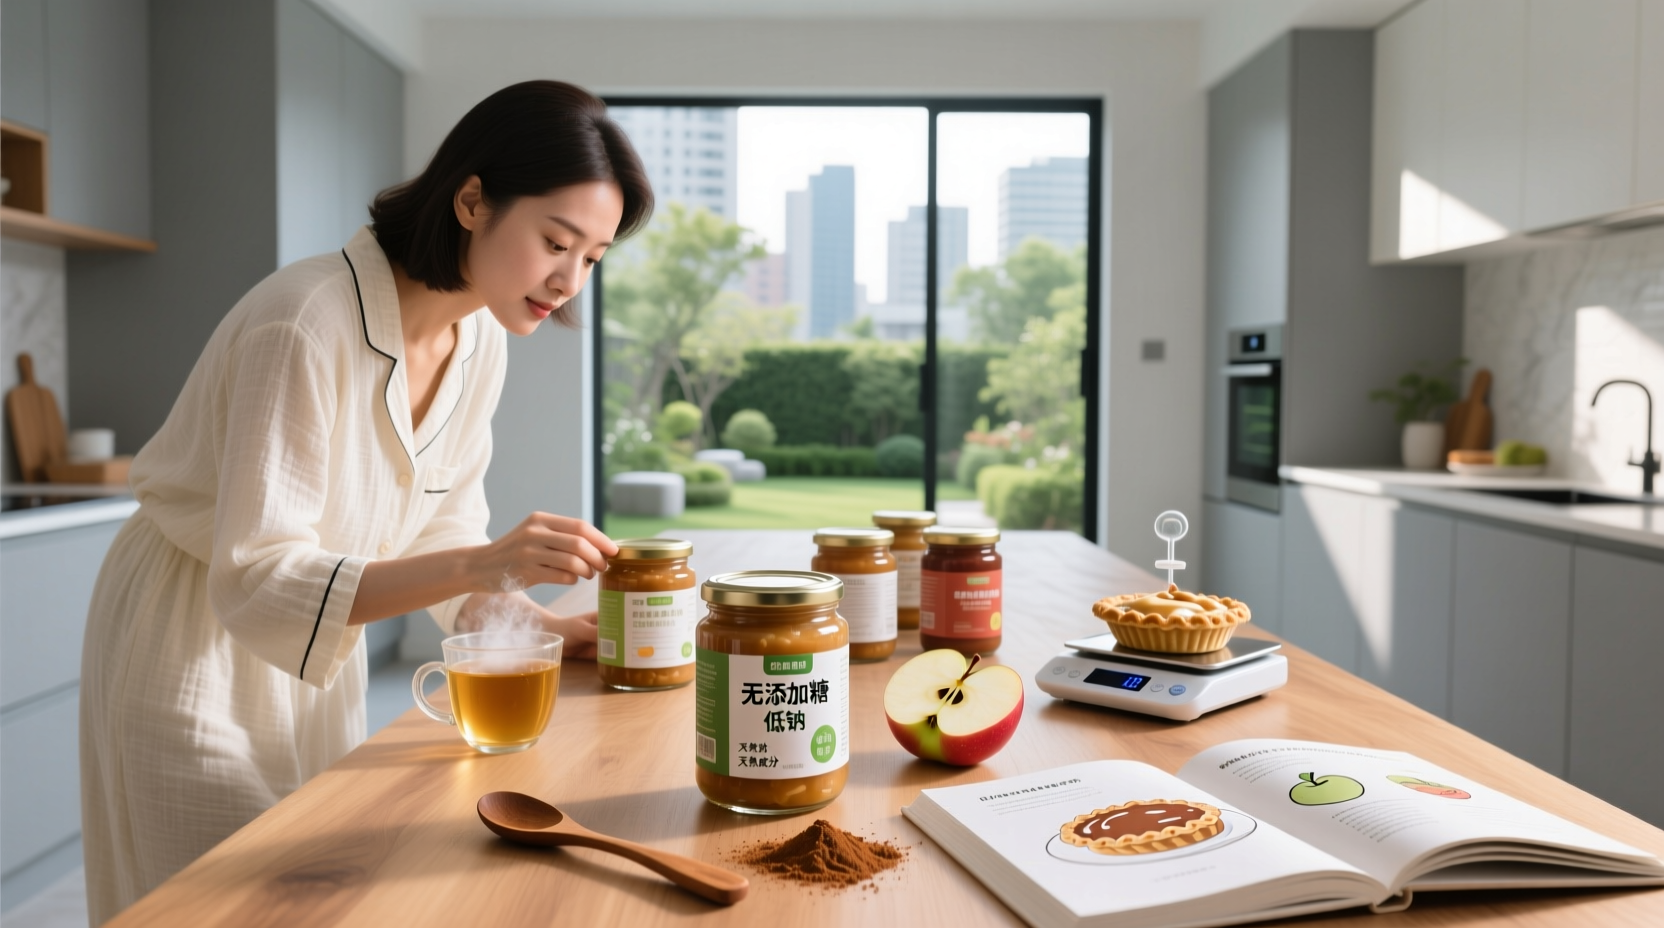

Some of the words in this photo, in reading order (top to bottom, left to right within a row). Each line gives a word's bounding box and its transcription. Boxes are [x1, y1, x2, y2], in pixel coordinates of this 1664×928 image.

[741, 678, 829, 706] 无添加糖
[763, 710, 805, 733] 低钠
